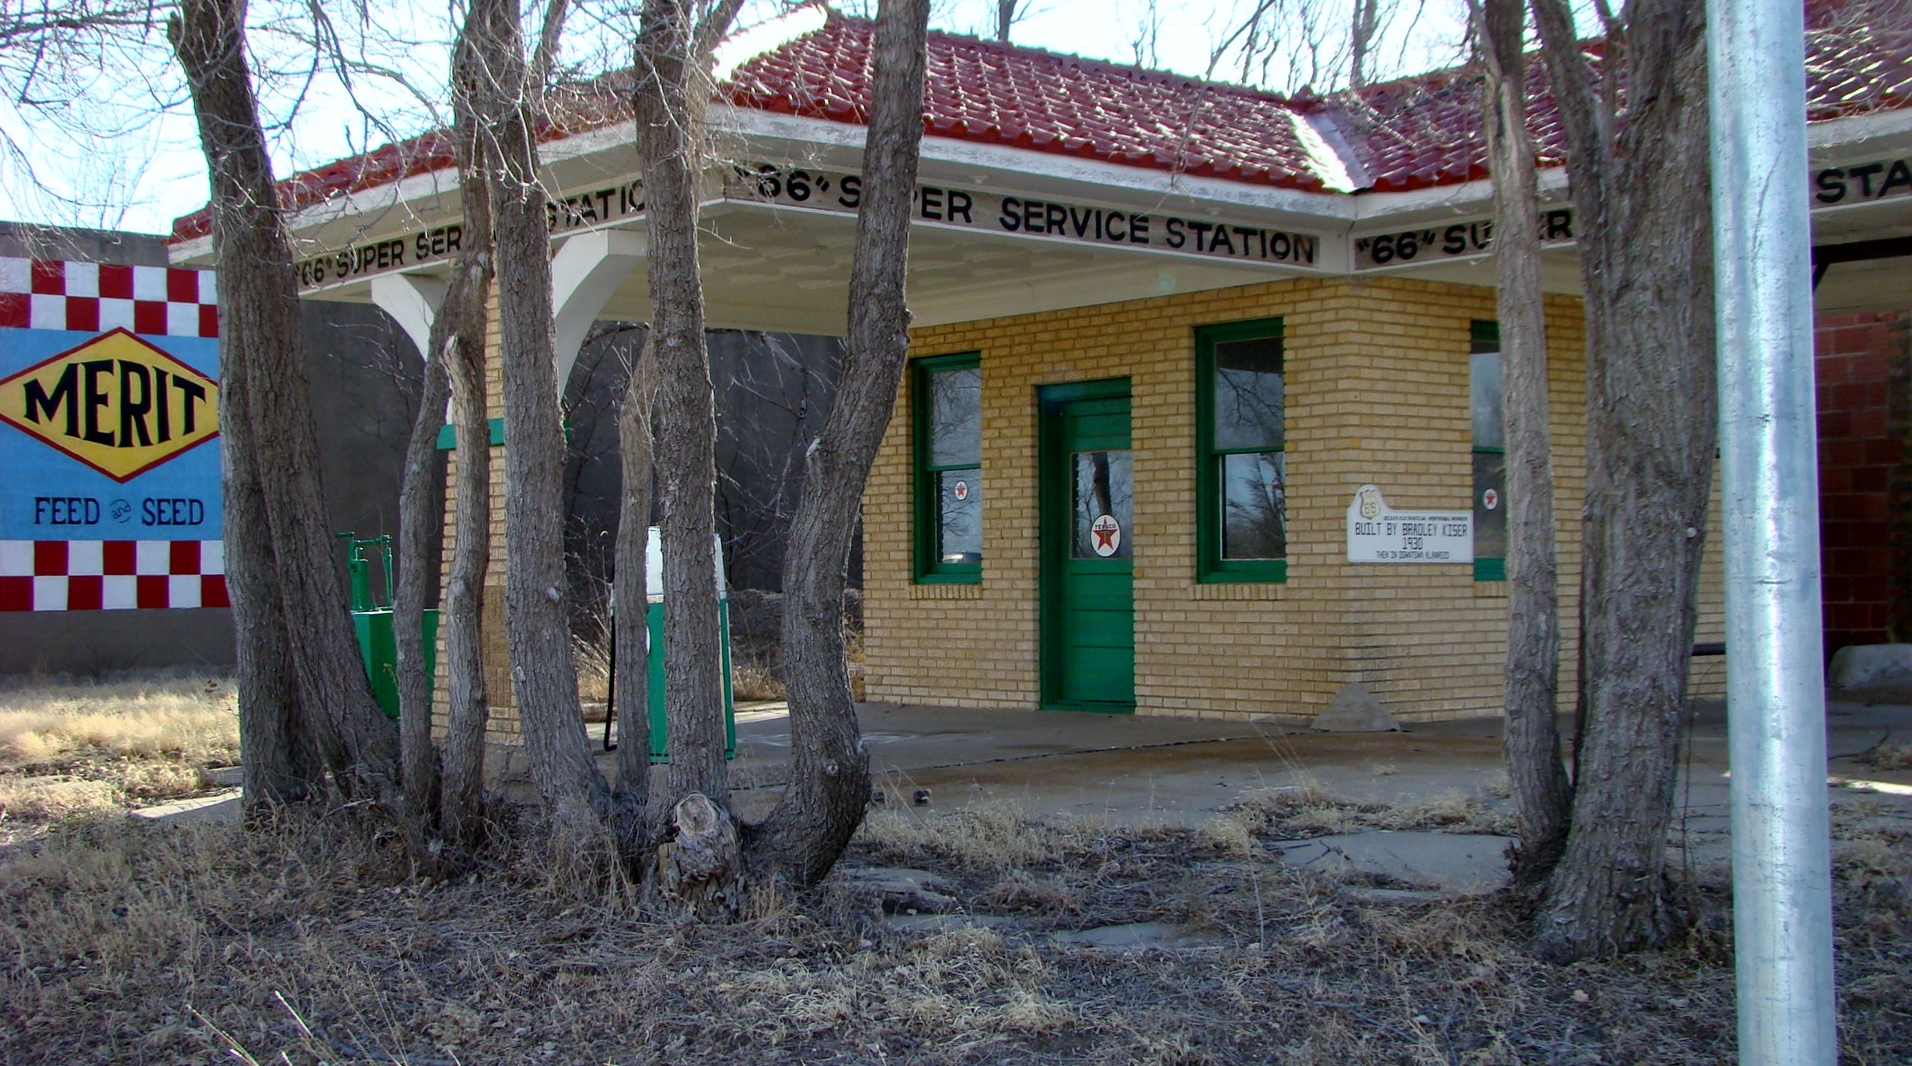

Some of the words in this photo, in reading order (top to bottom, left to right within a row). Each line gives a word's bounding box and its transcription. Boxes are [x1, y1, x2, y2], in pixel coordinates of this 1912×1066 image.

[336, 239, 405, 279] SUPER
[546, 179, 645, 232] STATIO
[838, 174, 972, 224] SER
[999, 196, 1150, 244] SERVICE
[1165, 217, 1316, 265] STATION
[1357, 229, 1437, 264] "66"
[1442, 207, 1574, 255] SUR
[23, 358, 207, 448] MERIT
[34, 497, 100, 525] FEED
[111, 502, 132, 521] and
[142, 498, 204, 526] SEED
[1355, 522, 1382, 536] BUILT
[1386, 522, 1398, 536] BY
[1402, 522, 1438, 537] BRADLEY
[1442, 523, 1468, 537] KISER
[1364, 501, 1377, 515] 66
[1402, 536, 1424, 550] 1930
